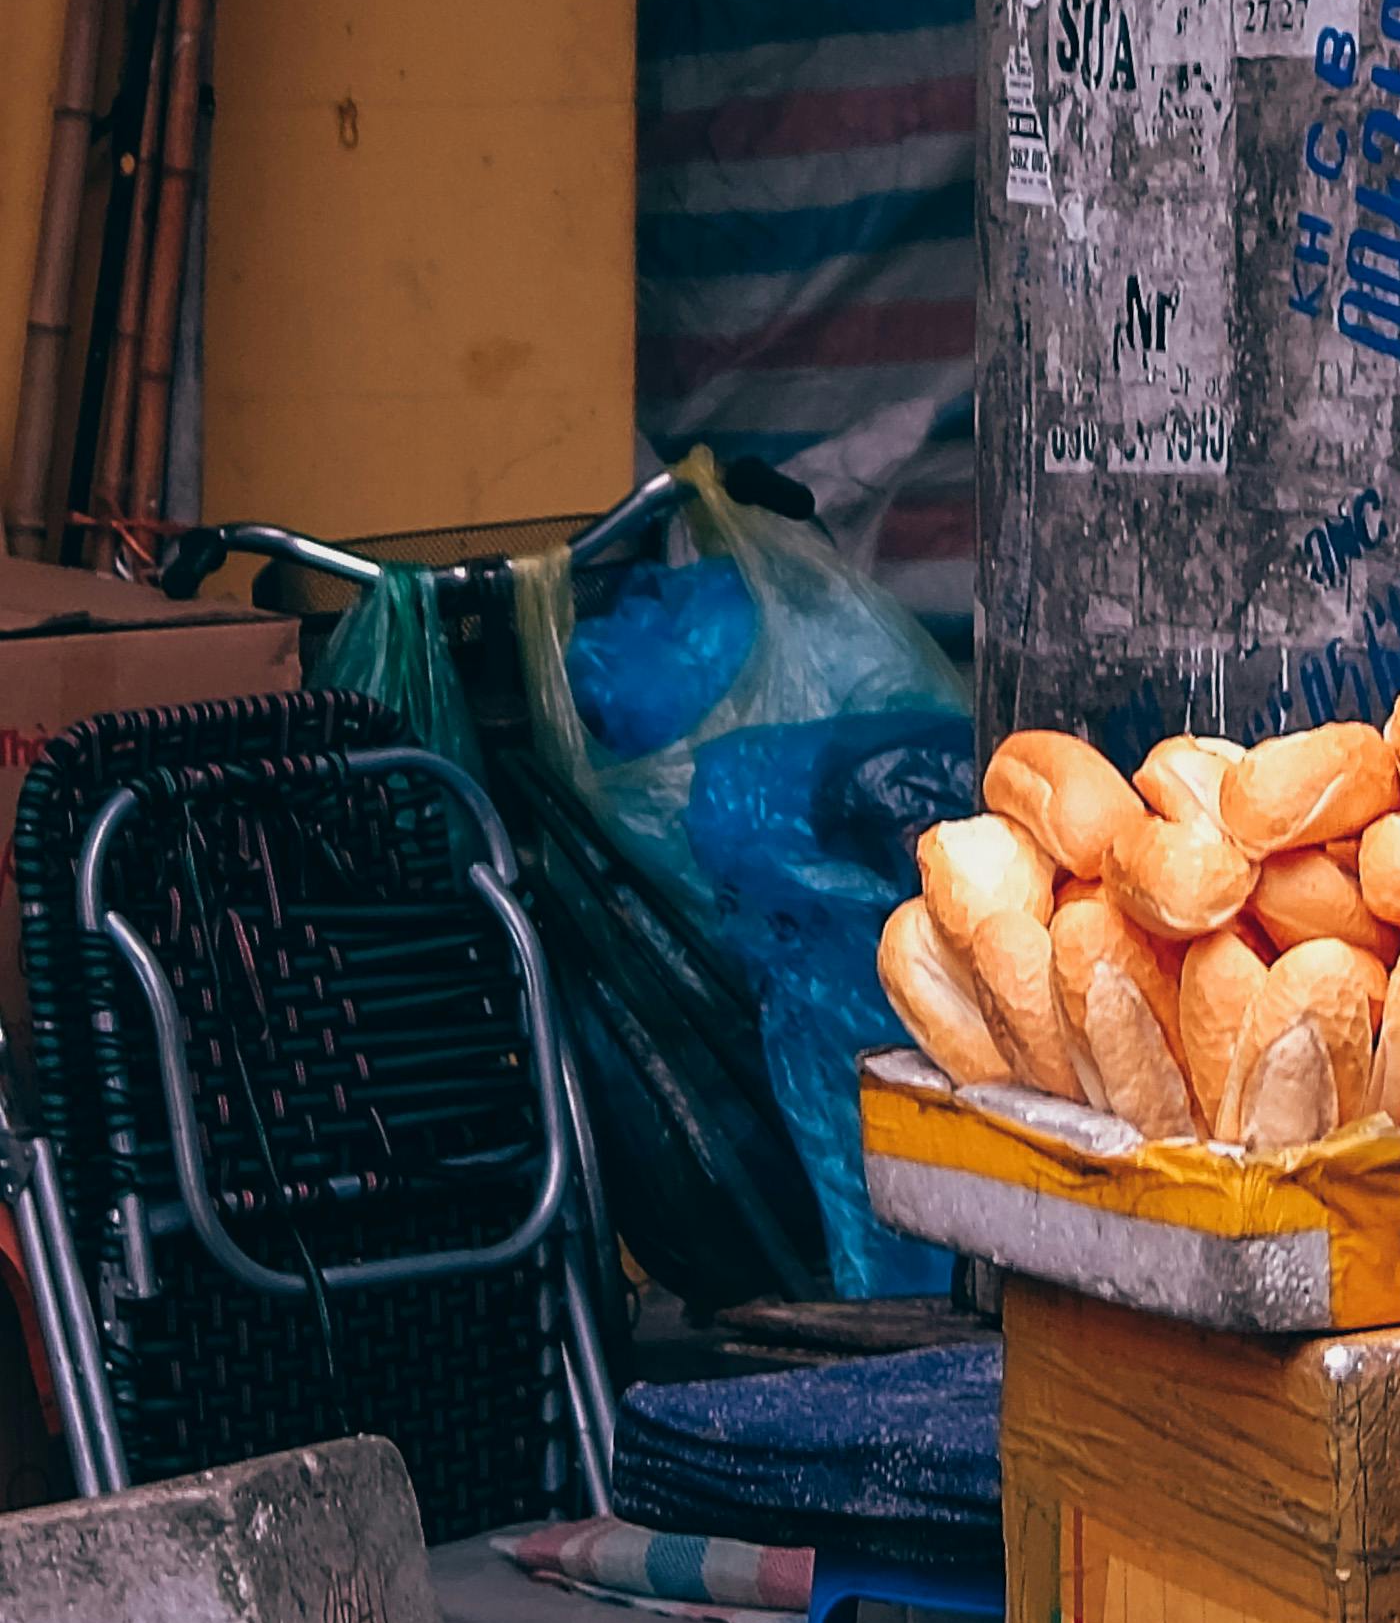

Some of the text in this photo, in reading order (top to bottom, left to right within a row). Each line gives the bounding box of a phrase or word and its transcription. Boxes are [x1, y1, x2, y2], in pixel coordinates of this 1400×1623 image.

[1314, 23, 1359, 91] B
[1305, 119, 1349, 182] C
[1288, 211, 1335, 317] KH
